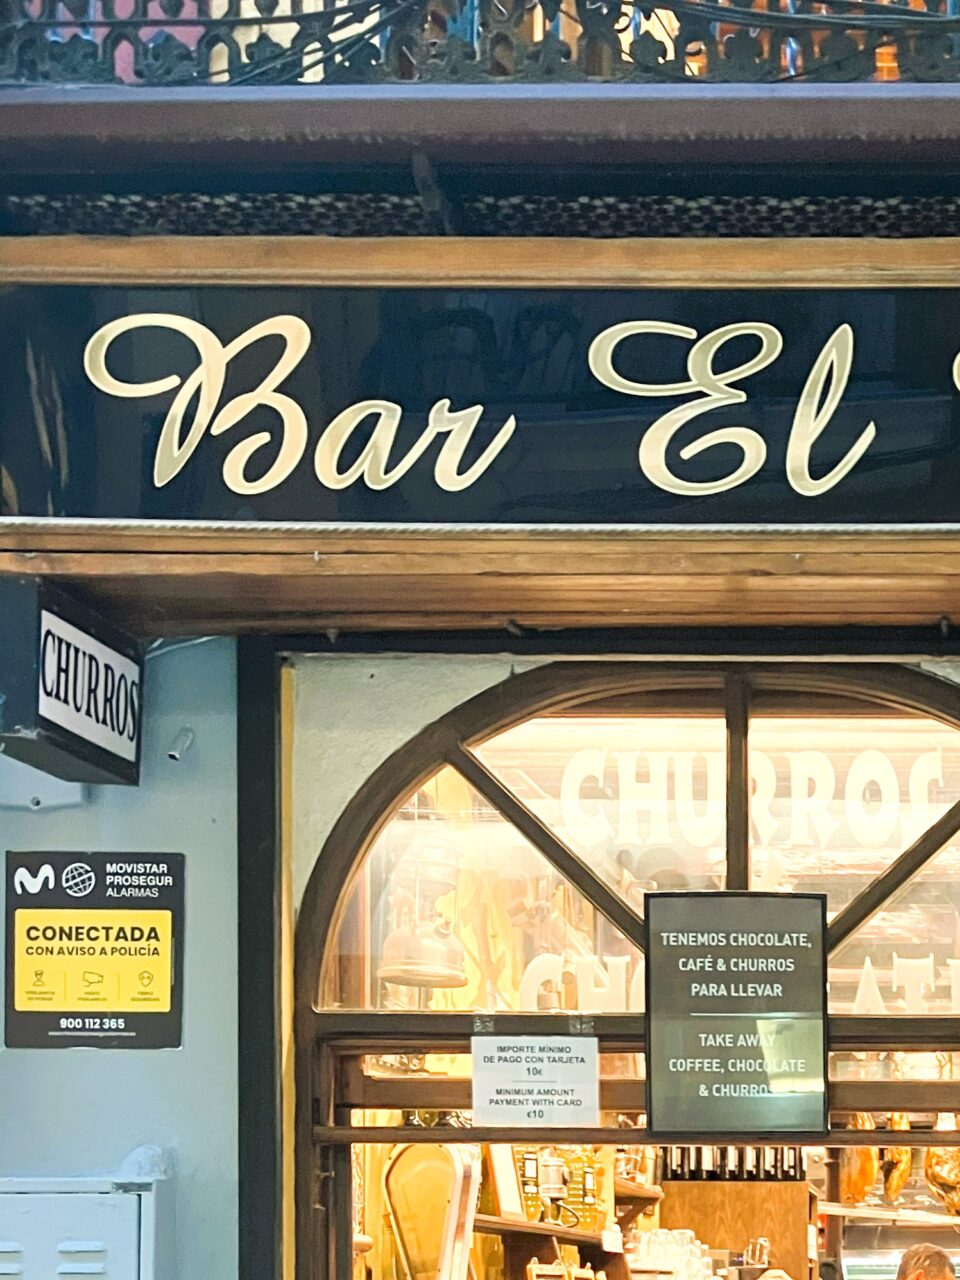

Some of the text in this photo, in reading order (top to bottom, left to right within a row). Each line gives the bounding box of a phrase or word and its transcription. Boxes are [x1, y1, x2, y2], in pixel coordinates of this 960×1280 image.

[83, 312, 517, 496] Bar
[588, 320, 877, 497] El
[41, 628, 139, 743] CHURROS
[106, 863, 168, 874] MOVISTAR
[106, 875, 173, 887] PROSEGUR
[106, 887, 160, 898] ALARMAS
[26, 926, 161, 942] CONECTADA
[660, 932, 812, 948] TENEMOS CHOCOLATE,
[25, 943, 161, 956] CON AVISO A POLICÍA
[678, 954, 795, 972] CAFÉ & CHURROS
[691, 984, 783, 997] PARA LLEVAR
[60, 1018, 125, 1029] 900 112 365
[699, 1034, 776, 1047] TAKE AWAY
[497, 1056, 522, 1064] PAGO
[547, 1056, 586, 1064] TARJETA
[669, 1059, 806, 1074] COFFEE, CHOCOLATE
[698, 1084, 709, 1097] &
[489, 1099, 529, 1107] PAYMENT
[557, 1099, 582, 1107] CARD
